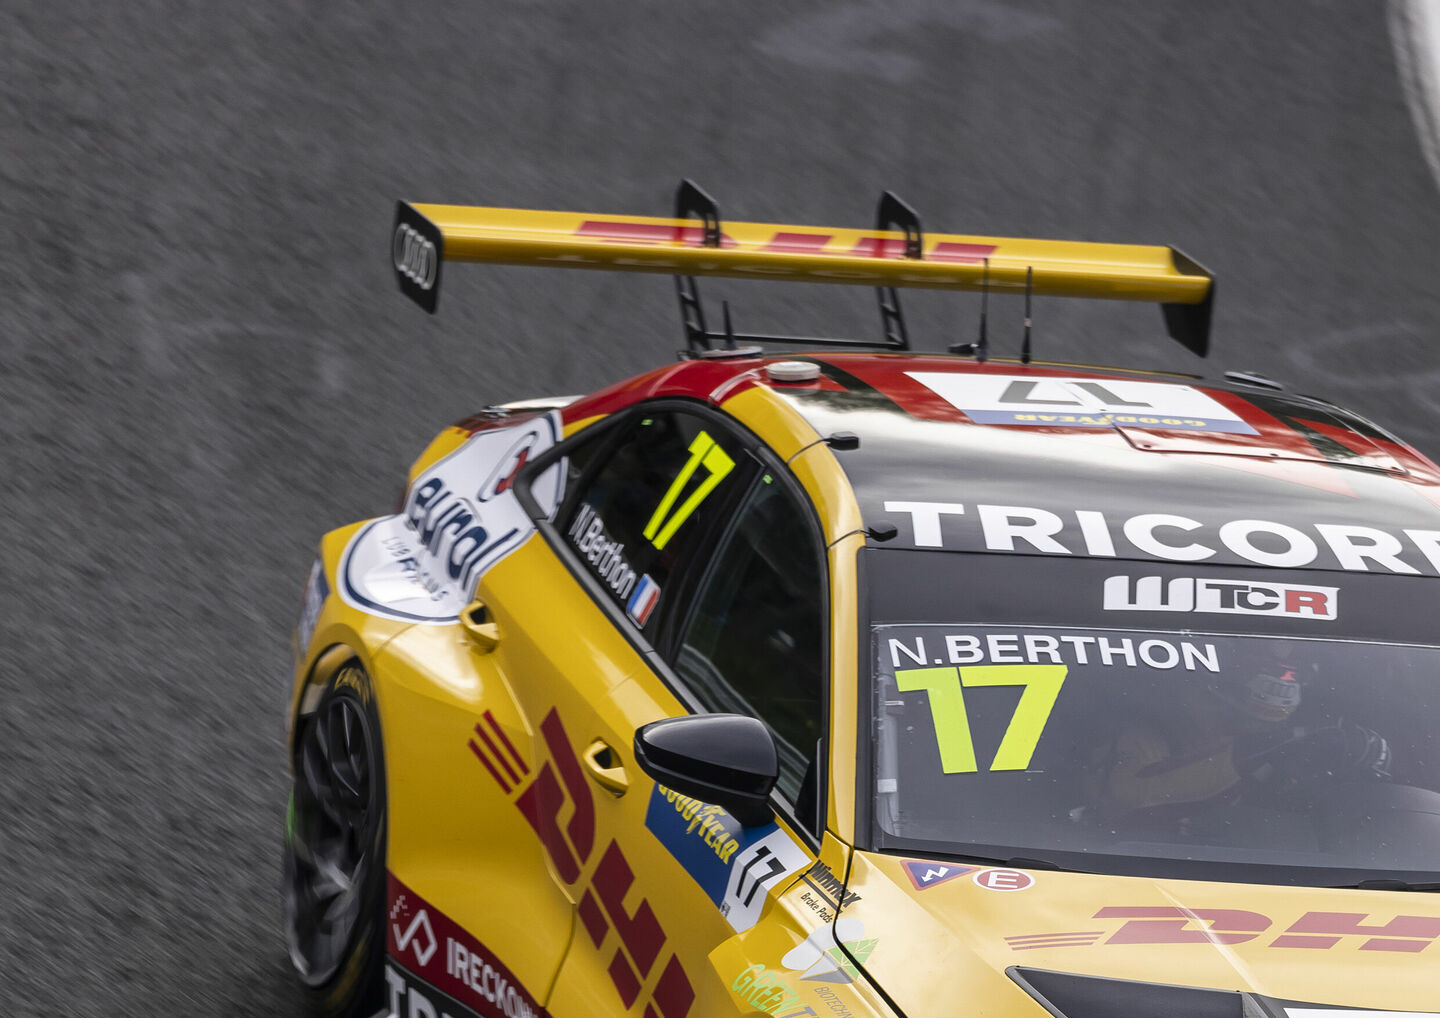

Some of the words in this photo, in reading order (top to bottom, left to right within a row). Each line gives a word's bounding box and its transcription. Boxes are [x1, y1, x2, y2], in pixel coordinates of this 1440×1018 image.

[998, 381, 1154, 408] 17
[643, 431, 736, 550] 17
[1103, 575, 1340, 621] WTCR
[888, 635, 1220, 672] N.BERTHON
[895, 665, 1068, 774] 17
[736, 846, 787, 908] 17
[800, 892, 819, 912] Brake
[816, 908, 833, 924] Pads
